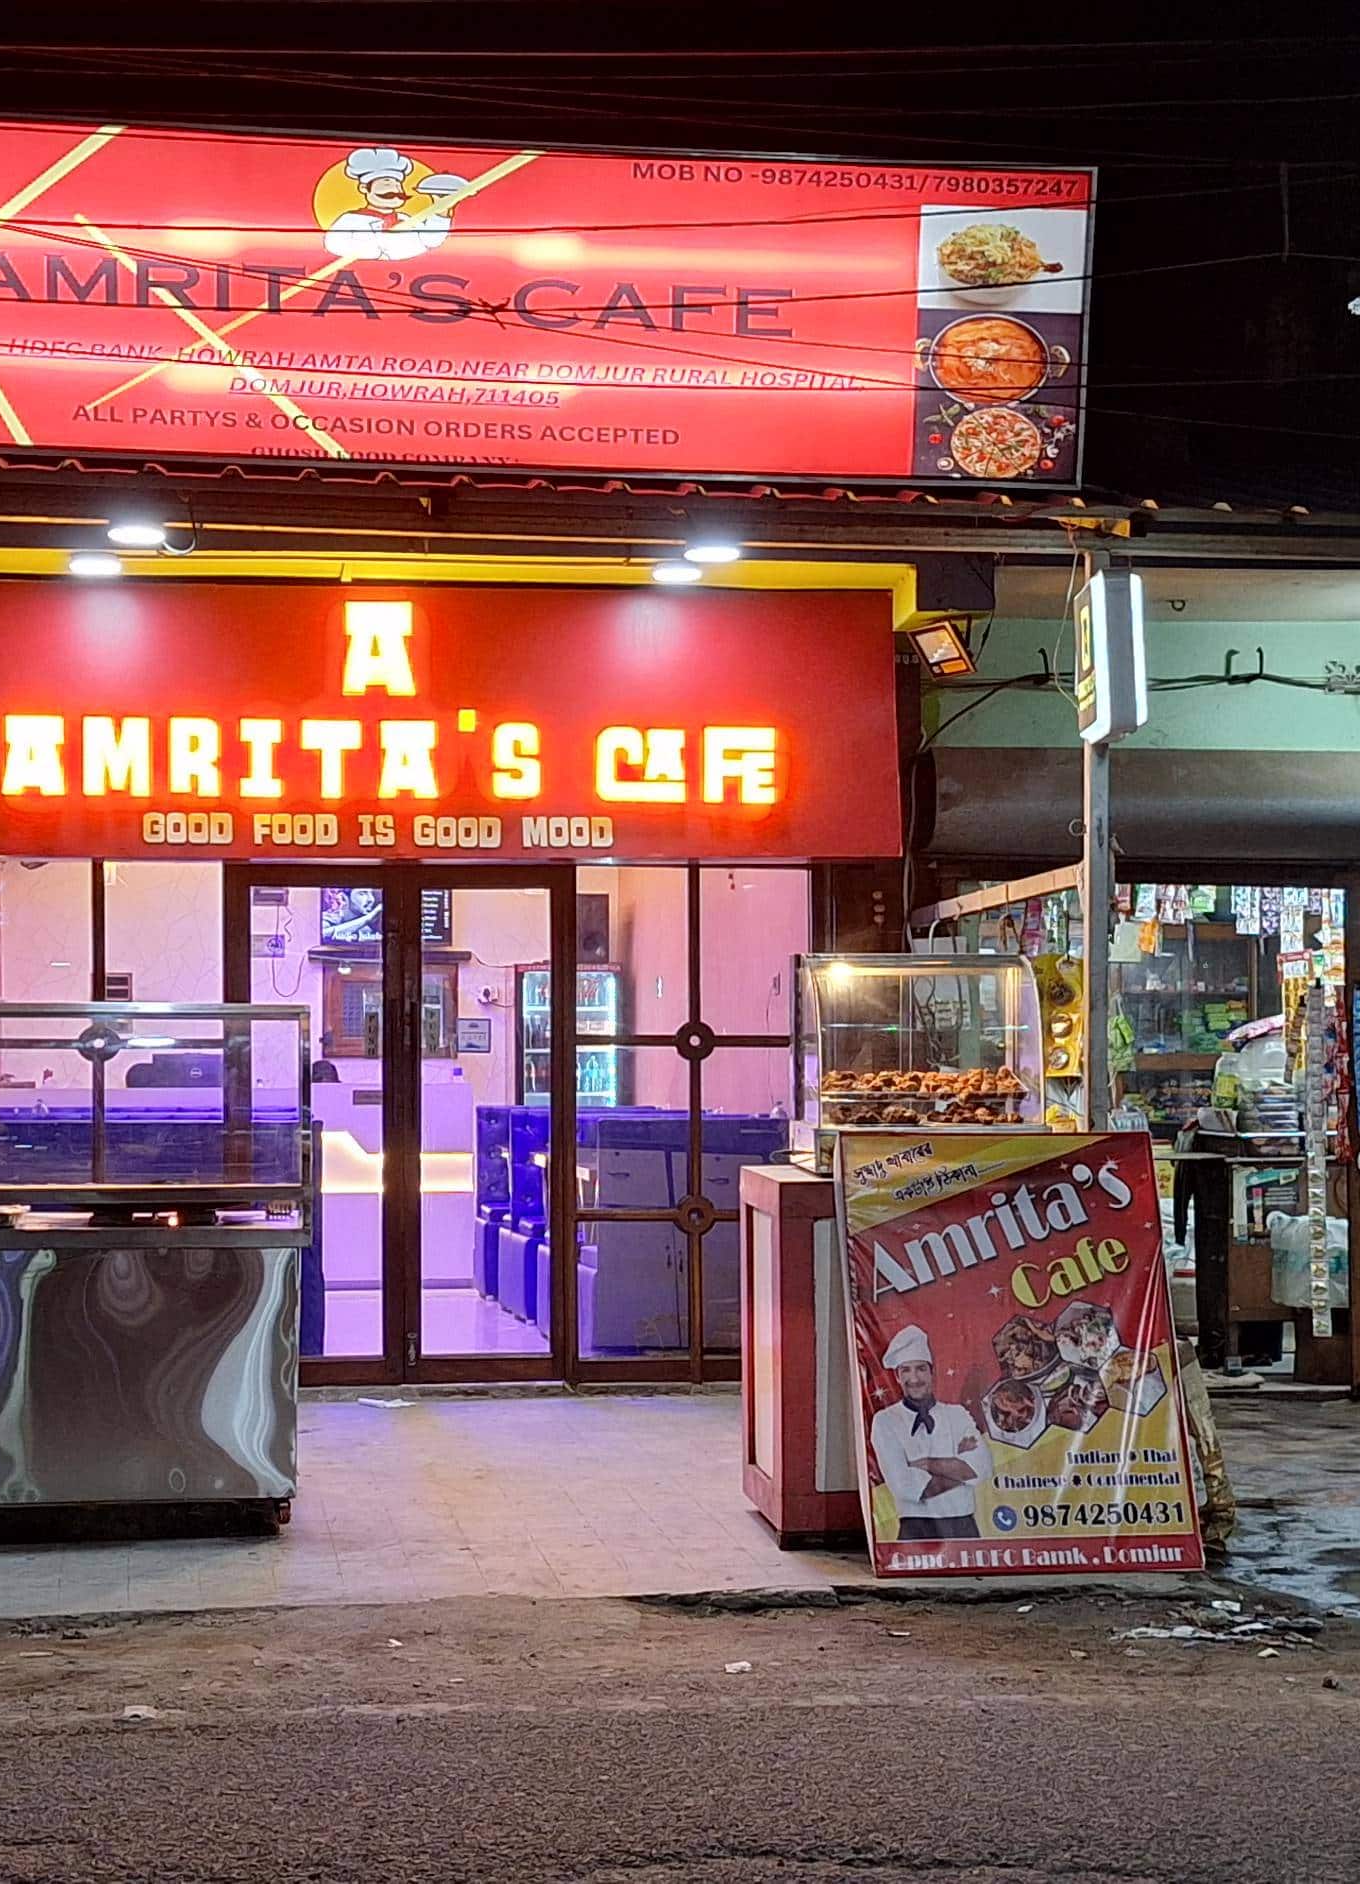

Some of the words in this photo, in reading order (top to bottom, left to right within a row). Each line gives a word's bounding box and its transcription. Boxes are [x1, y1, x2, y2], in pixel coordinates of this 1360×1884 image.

[632, 161, 696, 182] MOB
[704, 164, 742, 184] NO
[516, 279, 794, 338] CAFE
[9, 338, 84, 358] HDFC
[177, 346, 295, 368] HOWRAH
[301, 352, 374, 372] AMTA
[538, 362, 647, 383] DOMJUR
[651, 366, 732, 387] RURAL
[72, 404, 118, 423] ALL
[133, 407, 237, 429] PARTYS
[245, 412, 262, 429] &
[271, 413, 415, 437] OCCASION
[424, 419, 533, 441] ORDERS
[541, 424, 680, 447] ACCEPTED
[341, 598, 417, 698] A
[0, 707, 542, 801] AMRITA'S
[594, 723, 781, 805] CAFE
[142, 811, 234, 846] GOOD
[253, 811, 338, 848] FOOD
[358, 813, 397, 848] IS
[413, 814, 502, 850] GOOD
[521, 816, 614, 850] MOOD
[872, 1163, 1132, 1303] Amrita's
[1011, 1236, 1131, 1308] Cafe
[1066, 1450, 1122, 1465] Indian
[1143, 1448, 1177, 1463] Thai
[1023, 1501, 1185, 1528] 9874250431
[959, 1548, 1020, 1568] HDFC
[1104, 1544, 1184, 1565] Domjur
